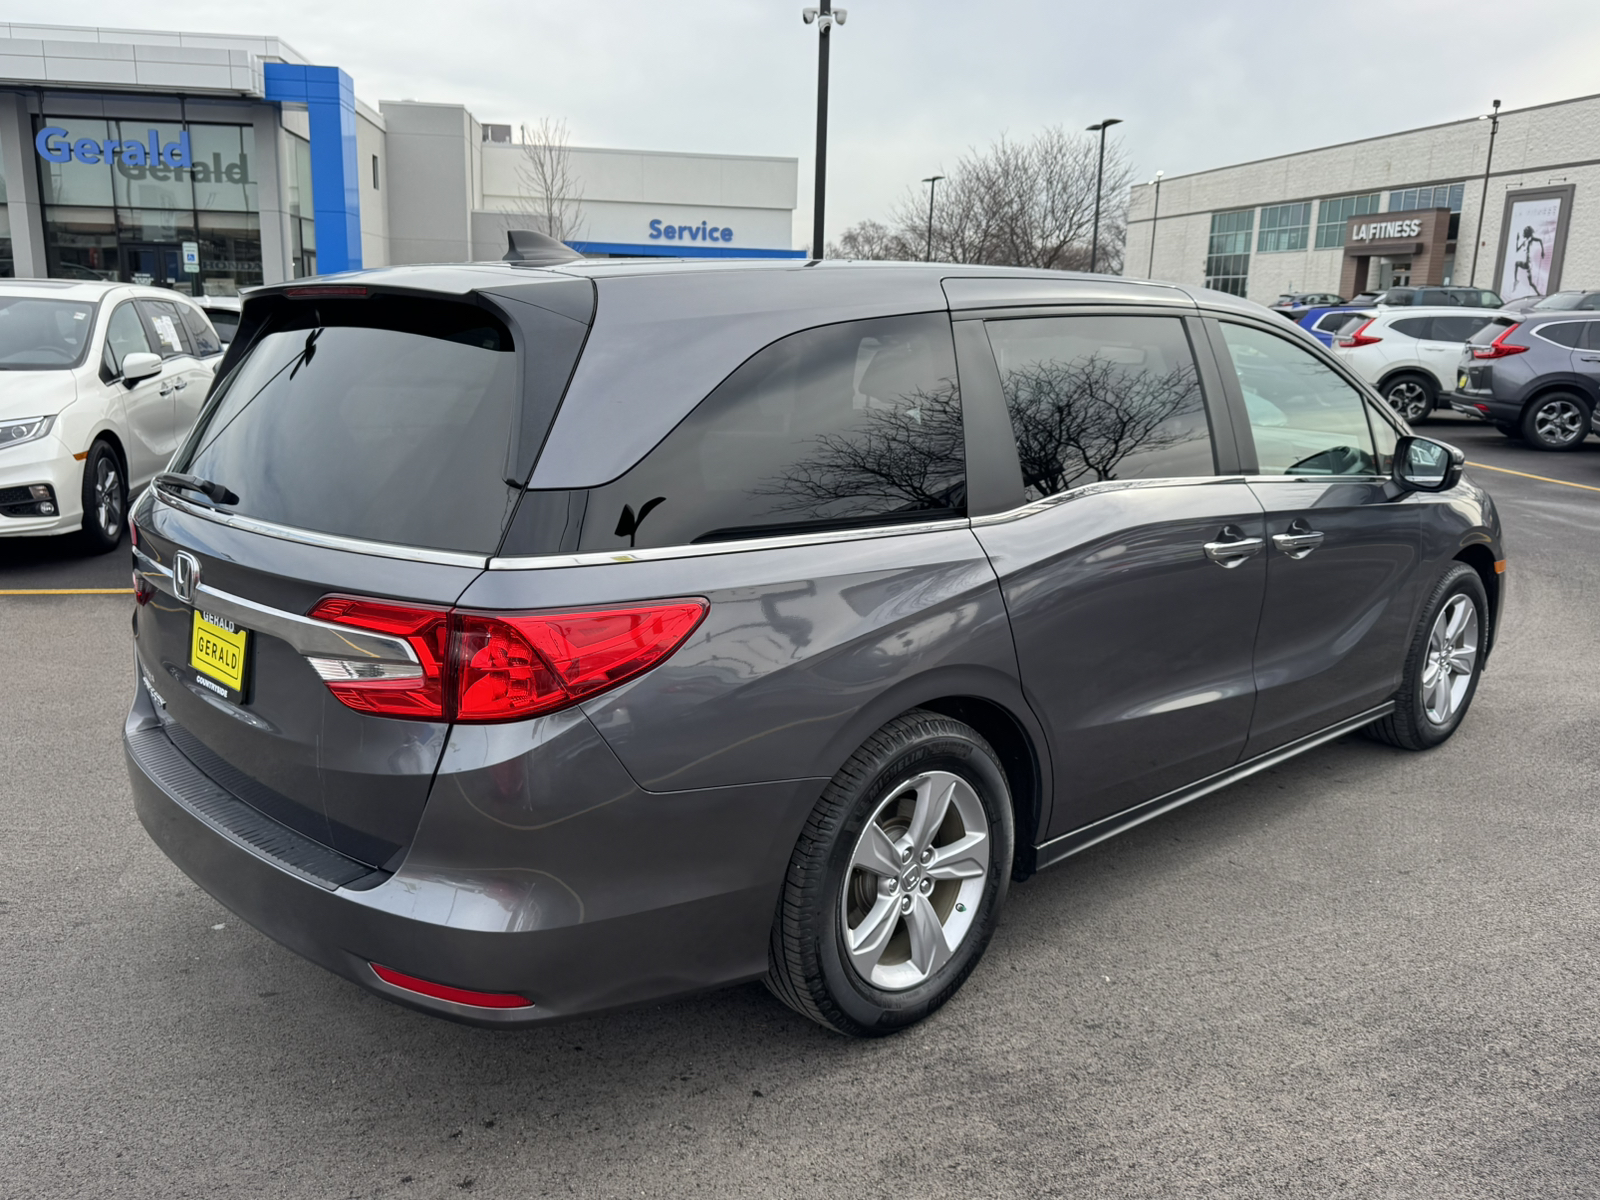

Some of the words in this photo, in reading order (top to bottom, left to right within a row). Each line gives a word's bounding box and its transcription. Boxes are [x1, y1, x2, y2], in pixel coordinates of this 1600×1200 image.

[35, 126, 192, 168] Gerald
[649, 219, 733, 242] Service
[1352, 224, 1367, 240] LA
[1369, 219, 1422, 239] FITNESS
[203, 611, 235, 633] GERALD
[198, 636, 238, 670] GERALD
[196, 675, 228, 698] COUNTRYSIDE
[869, 748, 924, 800] MICHELIN
